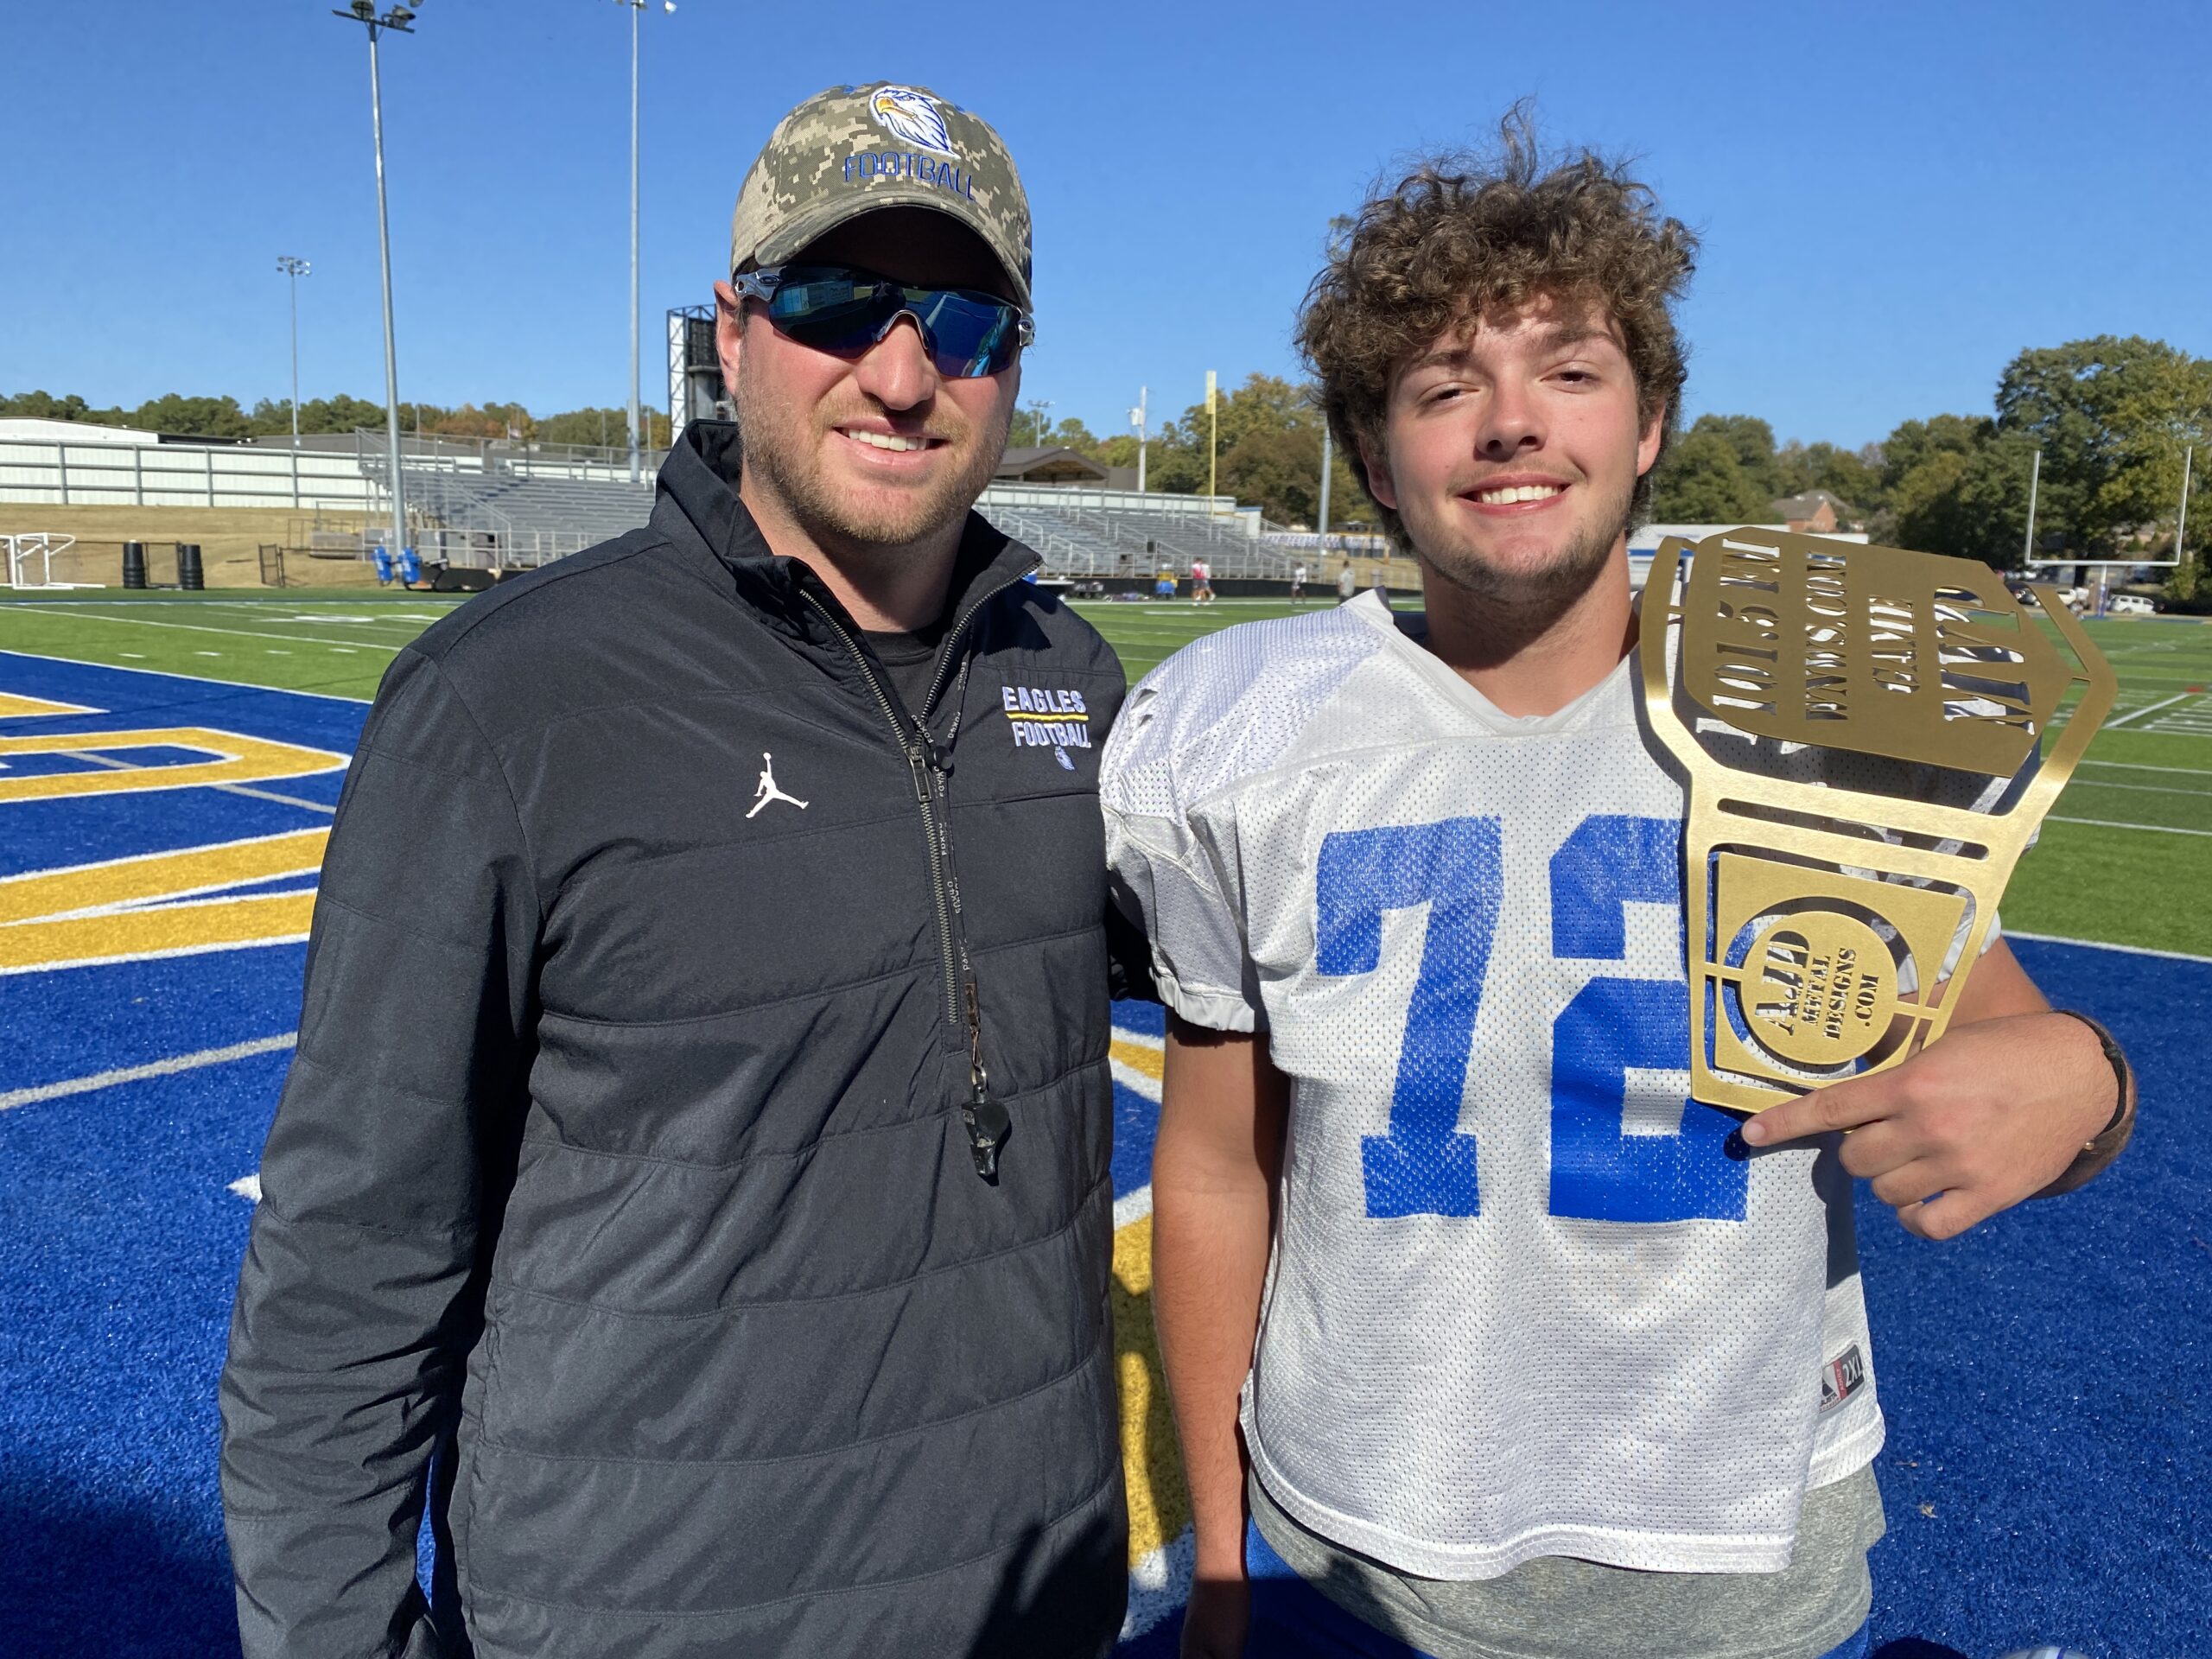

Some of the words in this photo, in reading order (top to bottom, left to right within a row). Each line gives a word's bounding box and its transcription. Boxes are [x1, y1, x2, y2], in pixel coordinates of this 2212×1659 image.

[844, 151, 976, 201] FOOTBALL
[1720, 538, 1781, 594] FM
[1713, 601, 1780, 715] 101.5
[1805, 550, 1849, 721] WNWS.COM
[1869, 594, 1919, 694] GAME
[1934, 585, 2036, 736] MVP
[1002, 686, 1086, 713] EAGLES
[1011, 721, 1092, 748] FOOTBALL
[1802, 955, 1832, 1027] METAL
[1823, 947, 1857, 1040] DESIGNS
[1854, 973, 1879, 1027] .COM
[1842, 1354, 1864, 1388] 2XL
